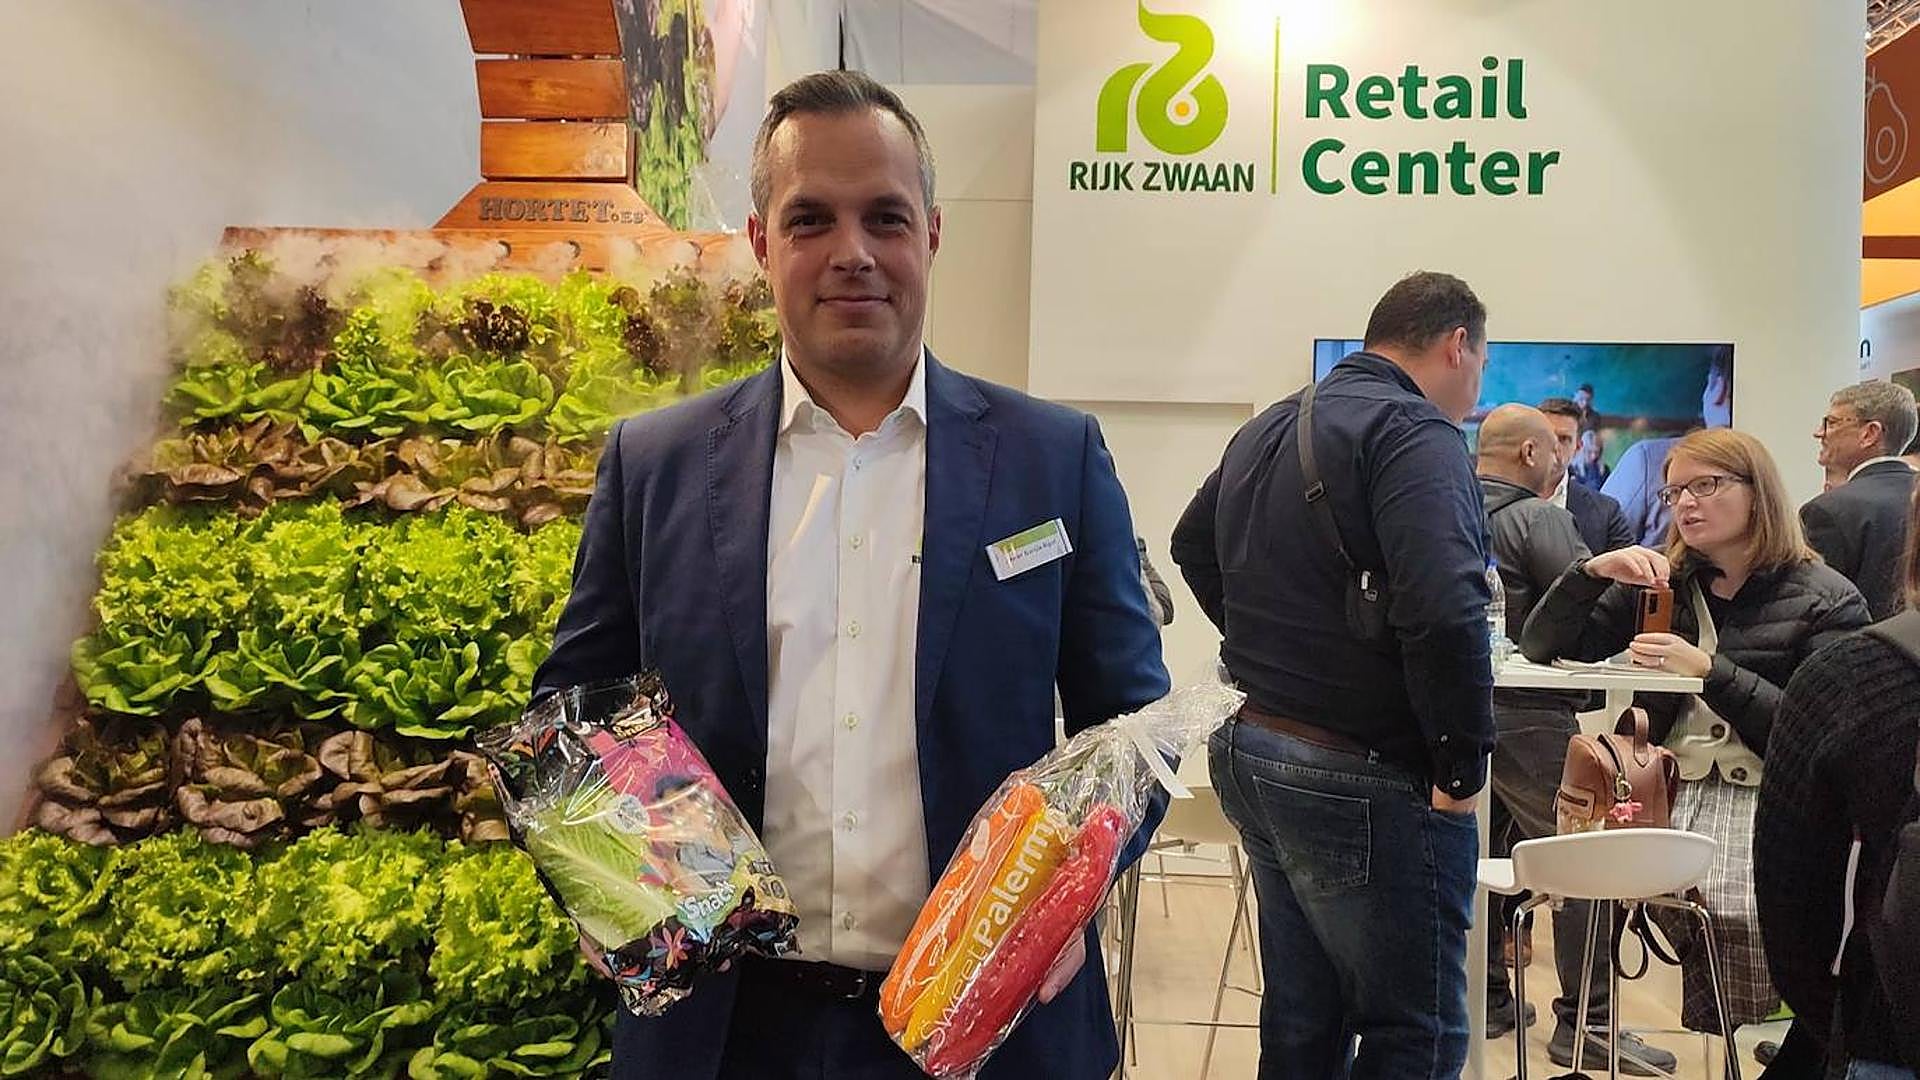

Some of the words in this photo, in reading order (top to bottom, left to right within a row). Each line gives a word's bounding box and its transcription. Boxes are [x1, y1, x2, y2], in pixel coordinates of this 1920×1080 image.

[1305, 55, 1528, 120] Retail
[1069, 160, 1134, 192] RIJK
[1142, 161, 1255, 193] ZWAAN
[1301, 138, 1561, 196] Center
